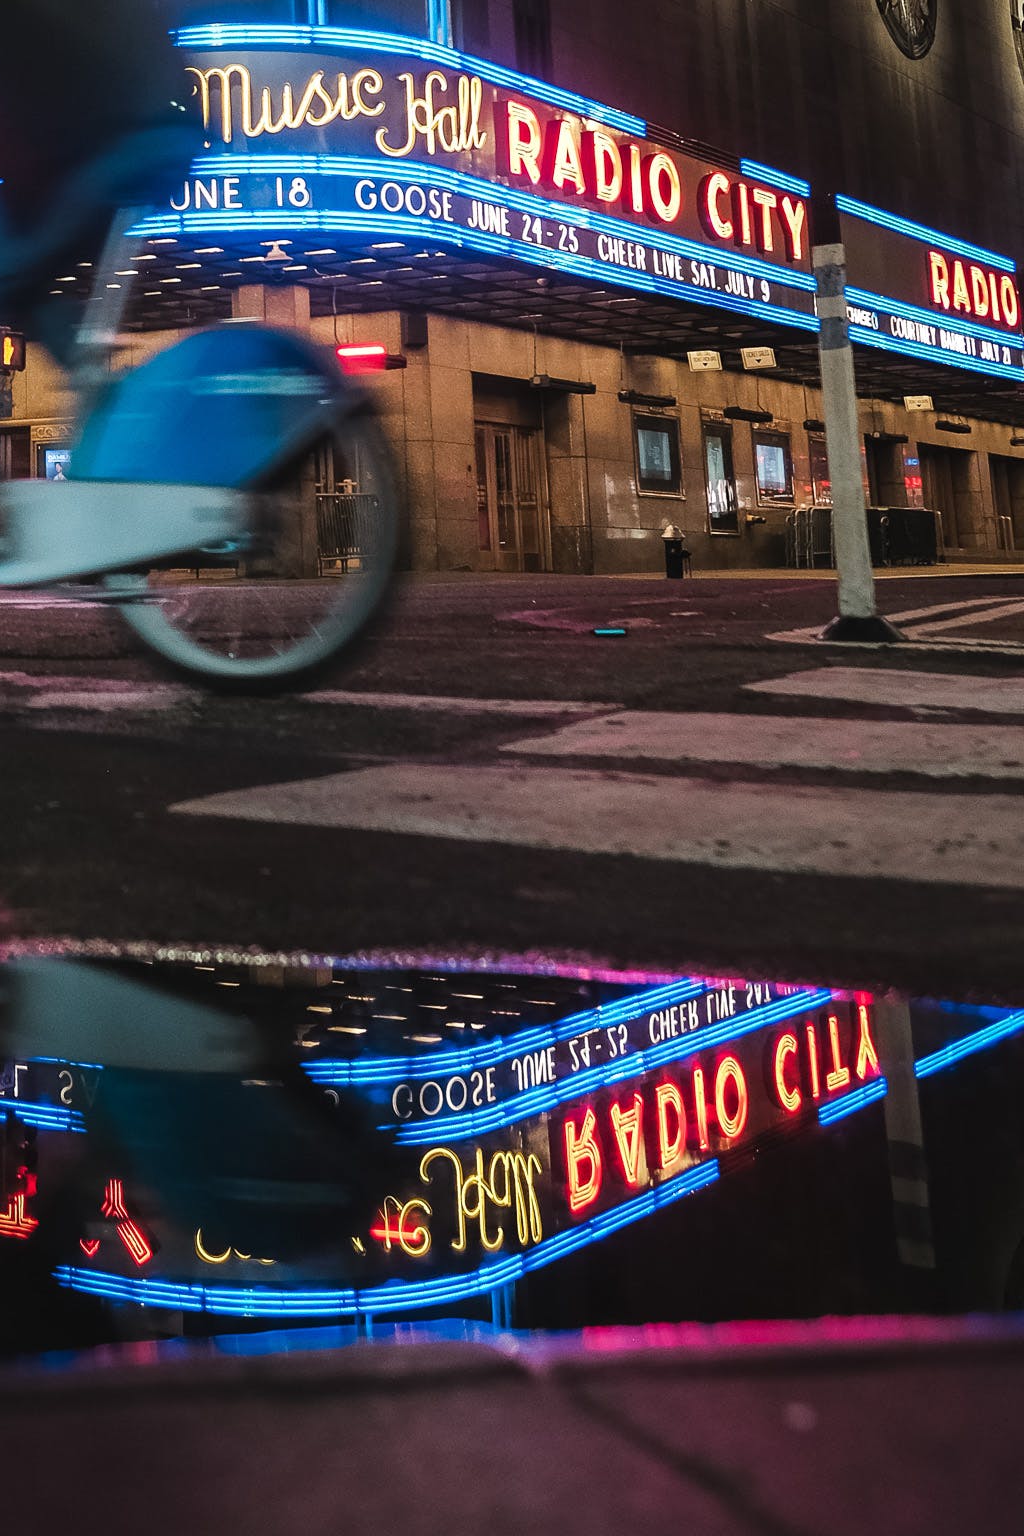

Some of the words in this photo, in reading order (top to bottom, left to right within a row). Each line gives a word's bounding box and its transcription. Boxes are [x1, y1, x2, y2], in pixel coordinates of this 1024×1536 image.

[375, 70, 487, 157] Hall
[276, 177, 310, 208] 18
[355, 179, 454, 222] GOOSE
[467, 200, 511, 235] JUNE
[506, 100, 681, 223] RADIO
[706, 170, 806, 261] CITY
[597, 233, 646, 271] CHEER
[653, 249, 684, 281] LIVE
[724, 271, 755, 300] JULY
[761, 283, 771, 303] 9
[929, 251, 1019, 328] RADIO
[890, 315, 938, 346] COURTNEY
[980, 341, 1000, 363] JULY
